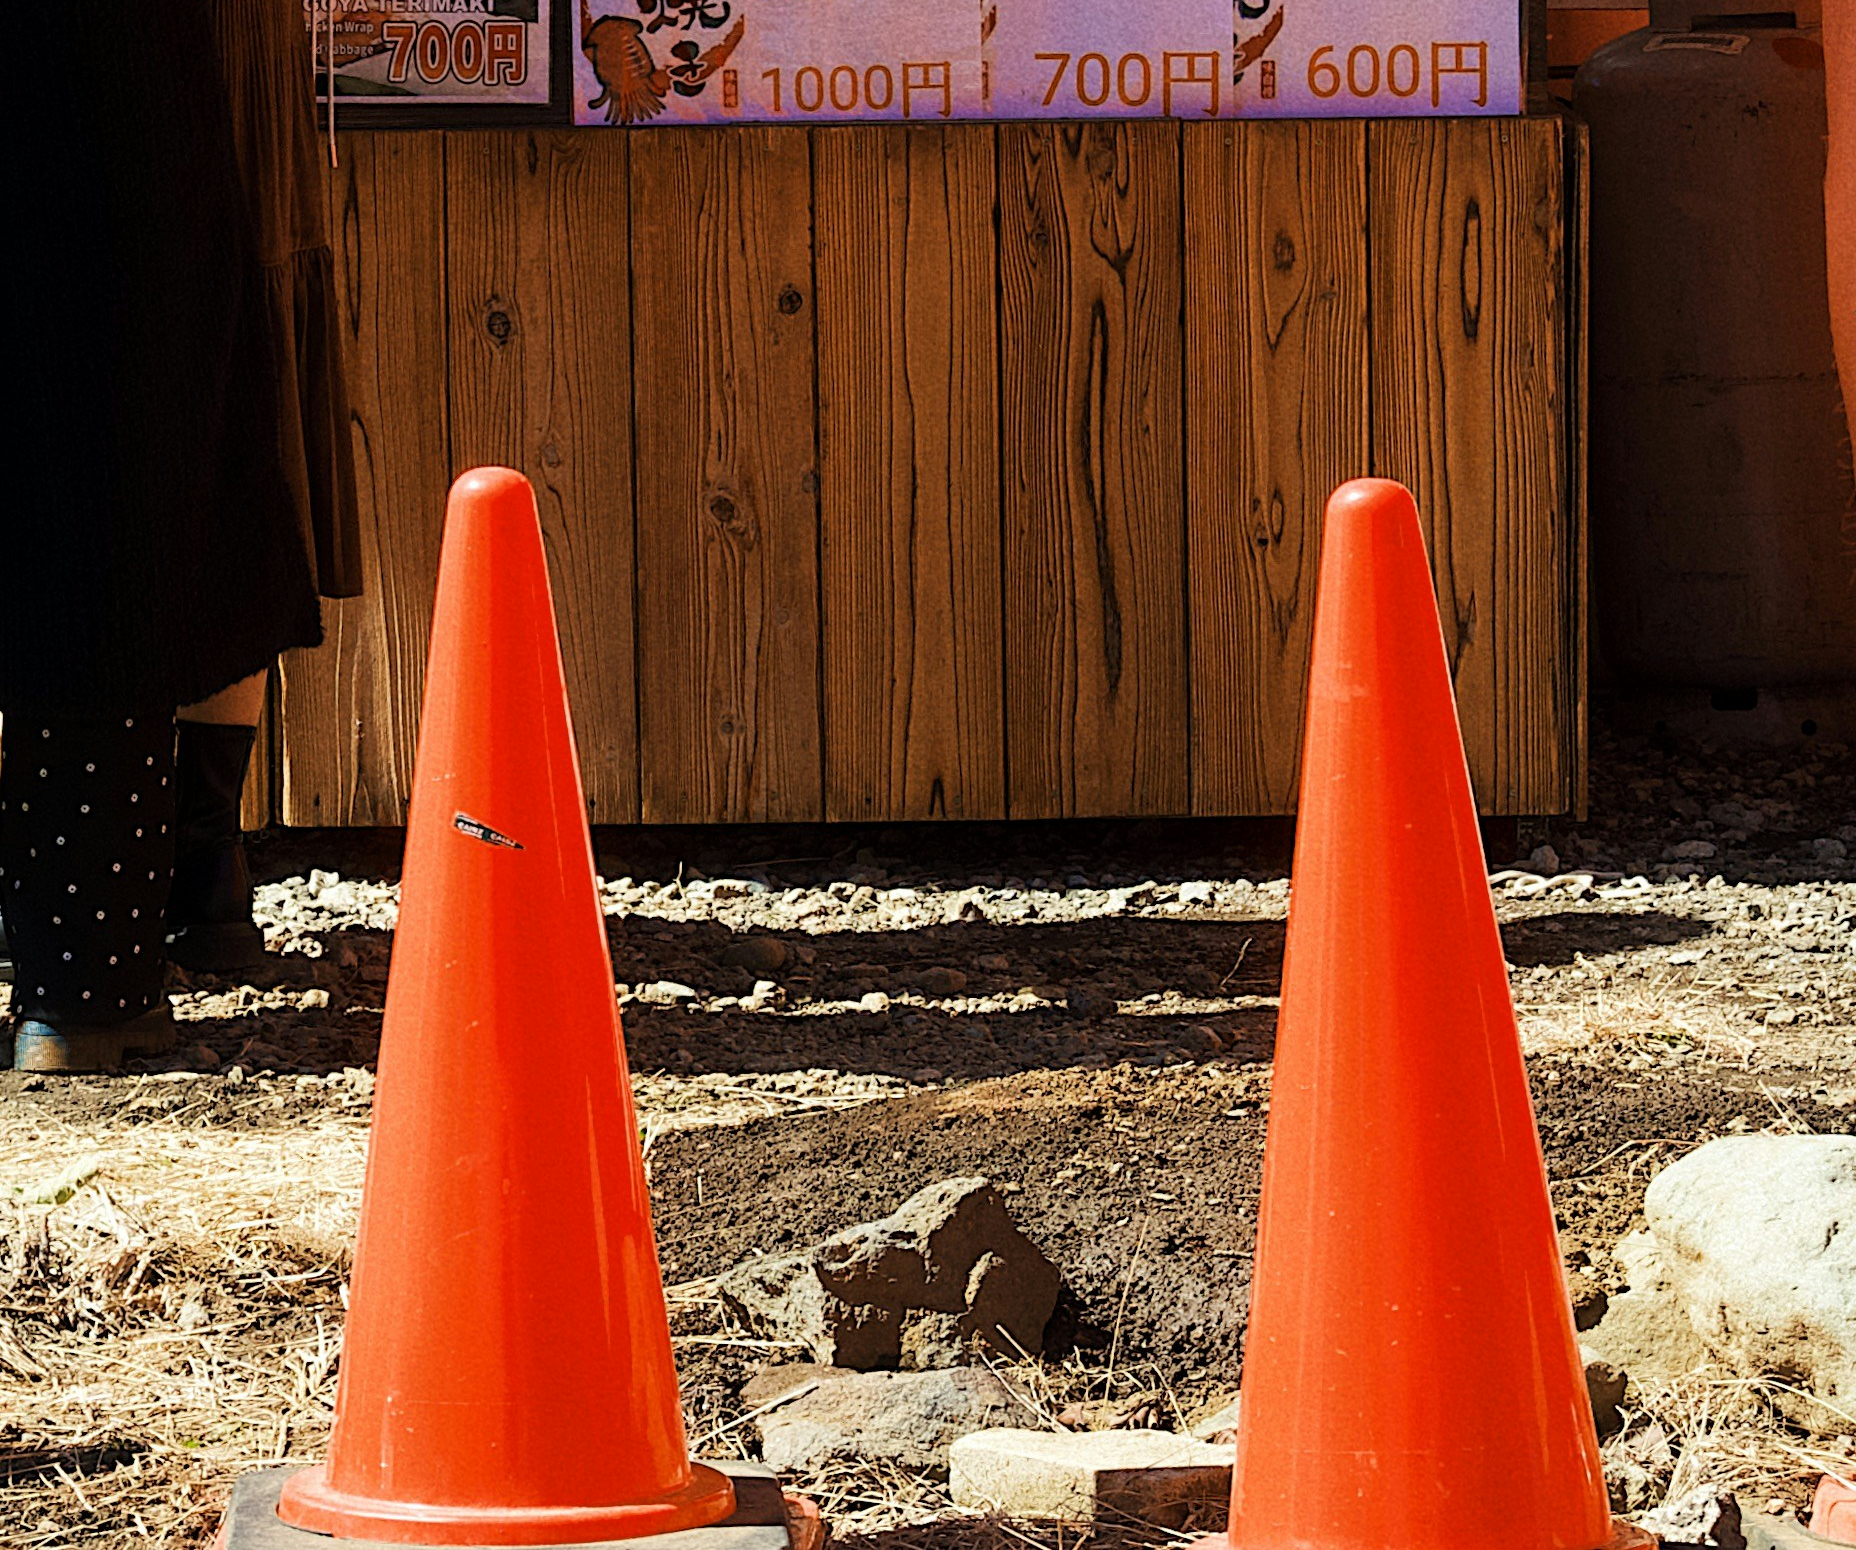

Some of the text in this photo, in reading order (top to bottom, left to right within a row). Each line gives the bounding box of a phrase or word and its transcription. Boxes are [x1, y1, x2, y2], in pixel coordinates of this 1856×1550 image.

[344, 21, 374, 35] Wrap
[383, 21, 526, 85] 700円
[760, 61, 952, 118] 1000円
[1034, 50, 1220, 118] 700円
[1307, 40, 1488, 108] 600円
